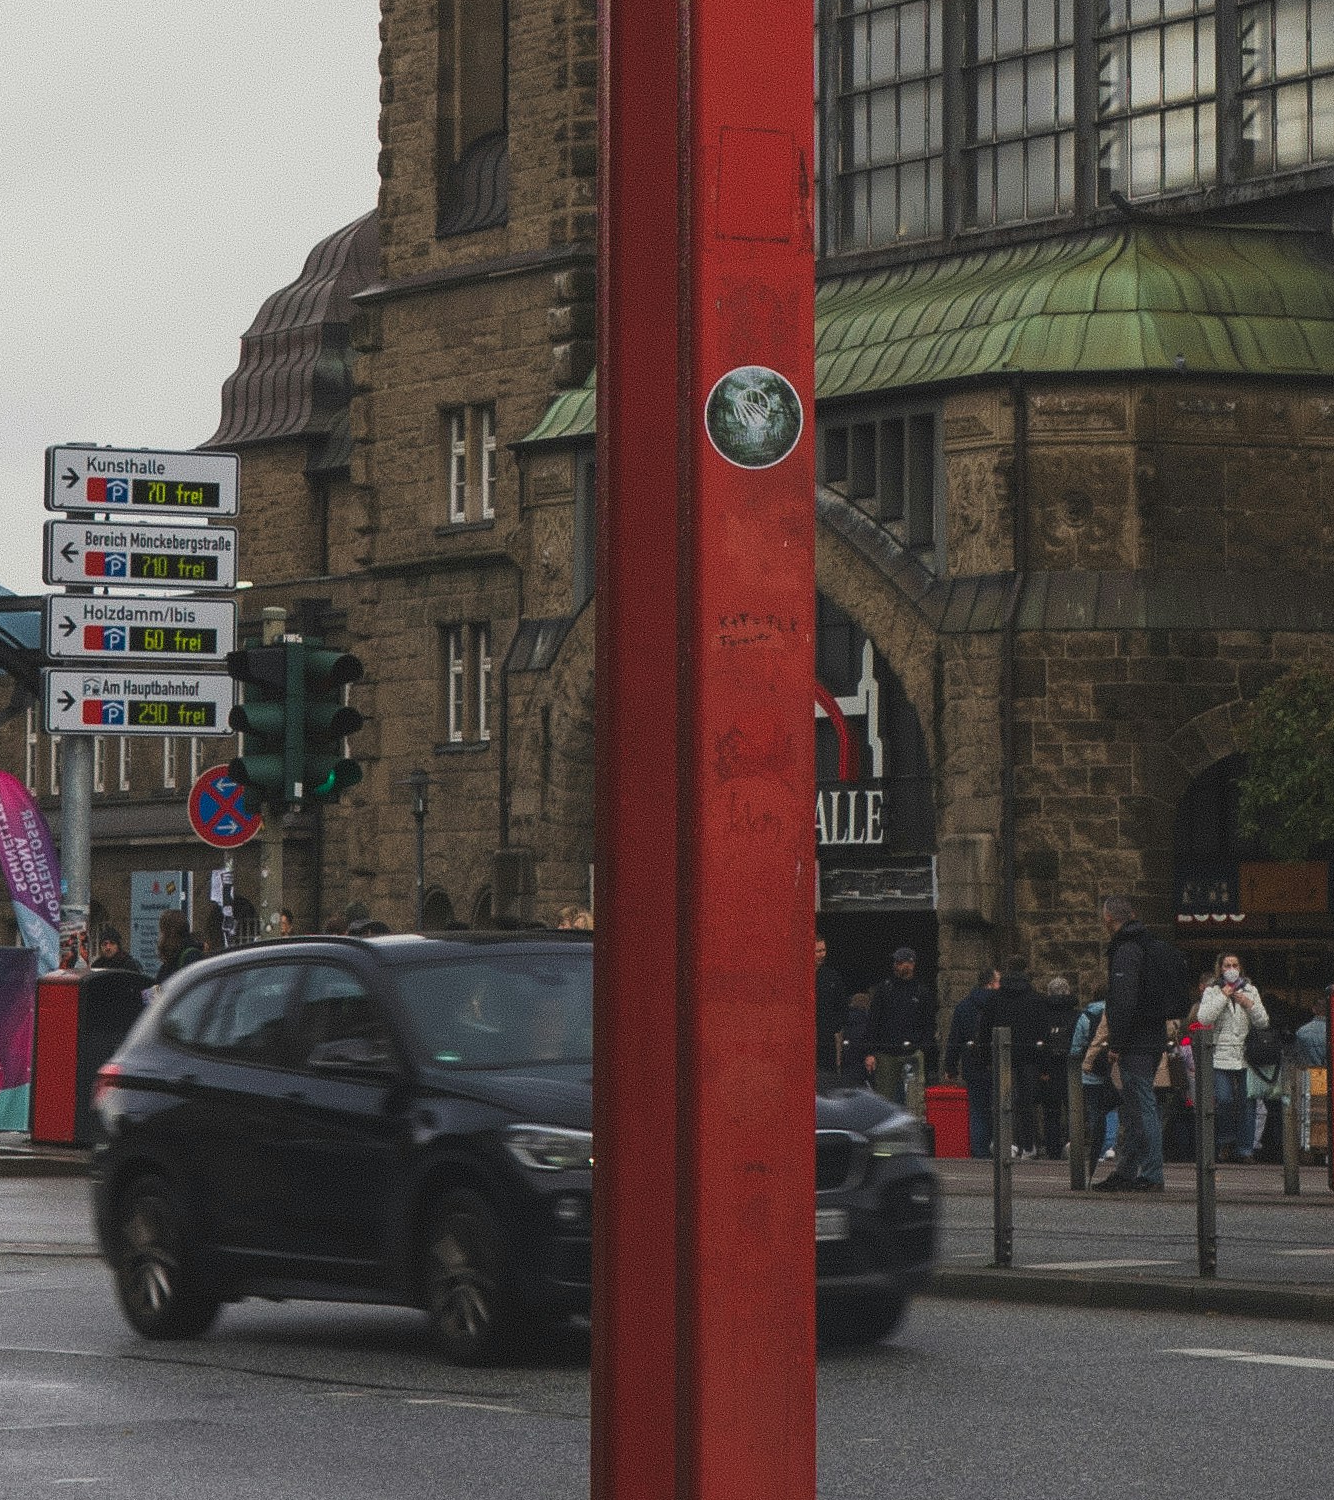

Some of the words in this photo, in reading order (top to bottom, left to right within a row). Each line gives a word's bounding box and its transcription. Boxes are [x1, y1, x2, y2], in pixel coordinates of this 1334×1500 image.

[86, 456, 166, 475] Kunsthalle
[147, 482, 166, 504] 70
[176, 483, 204, 505] frei
[85, 530, 127, 548] Bereich
[130, 531, 232, 554] Mönckebergstraße
[141, 556, 167, 577] 710
[177, 557, 205, 578] frei
[83, 603, 196, 623] Holzdamm/Ibis
[143, 629, 164, 651] 60
[174, 630, 202, 652] frei
[102, 678, 121, 695] Am
[123, 679, 200, 699] Hauptbahnhof
[138, 703, 167, 725] 290
[177, 704, 205, 726] frei
